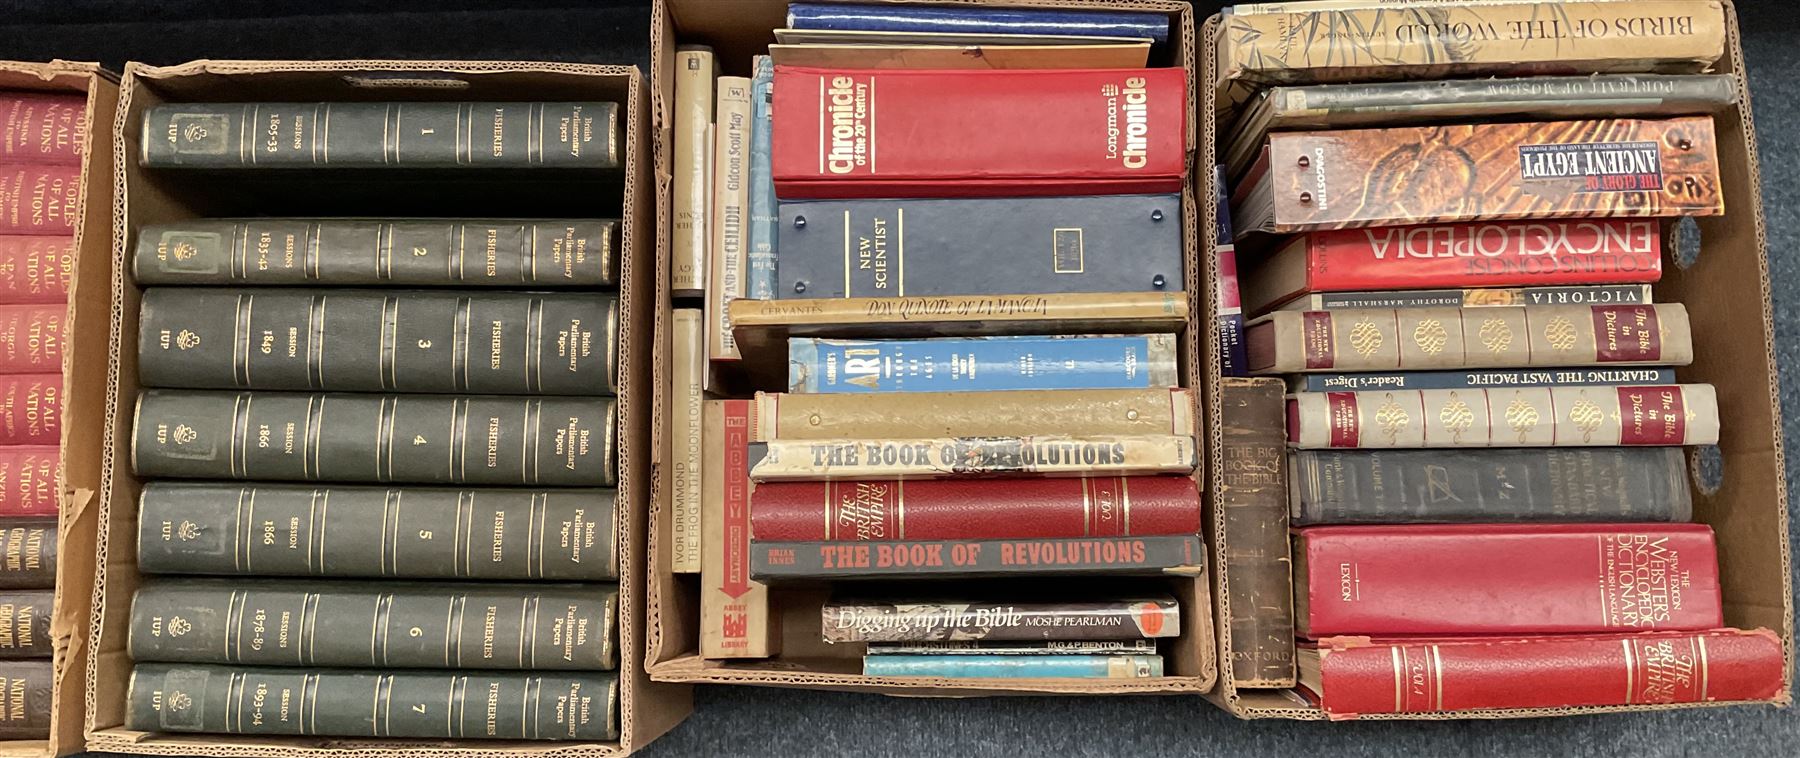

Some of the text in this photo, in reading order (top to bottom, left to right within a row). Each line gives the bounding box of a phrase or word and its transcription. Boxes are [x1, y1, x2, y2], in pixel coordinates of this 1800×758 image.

[1395, 21, 1497, 44] WORLD
[1506, 18, 1567, 40] THE
[1575, 17, 1609, 38] OF
[1616, 15, 1694, 35] BIRDS
[855, 83, 867, 118] Century
[1486, 79, 1675, 95] PORTRAIT OF MOSCOW
[40, 103, 59, 153] NATIONS
[267, 114, 278, 153] 1805-33
[493, 108, 503, 157] FISHERIES
[728, 112, 741, 131] May
[828, 76, 854, 173] Chronicle
[1106, 98, 1119, 159] Longman
[1122, 77, 1147, 168] Chronicle
[855, 138, 866, 154] the
[855, 155, 865, 165] of
[727, 158, 741, 191] Gideon
[1522, 149, 1657, 178] ANCIENT EGYPT
[1602, 175, 1637, 189] GLORY
[1640, 174, 1660, 189] THE
[32, 173, 49, 226] NATIONS
[48, 179, 63, 222] OF ALL
[259, 233, 270, 270] 1835-42
[486, 229, 496, 276] FISHERIES
[860, 237, 870, 269] NEW
[874, 218, 886, 288] SCIENTIST
[1365, 222, 1652, 258] ENCYCLOPEDIA
[1465, 255, 1651, 276] COLLINS CONCISE
[761, 305, 823, 317] CERVANTES
[868, 300, 895, 315] DON
[899, 299, 951, 320] QUIXOTE
[957, 300, 975, 315] OF
[1353, 299, 1403, 307] MARSHALL
[1410, 297, 1458, 305] DOROTHY
[1532, 291, 1637, 304] VICTORIA
[161, 331, 170, 349] IUP
[261, 331, 272, 353] 1849
[289, 327, 297, 357] SESSION
[419, 340, 431, 348] 3
[492, 320, 501, 369] FISHERIES
[558, 331, 566, 356] Papers
[569, 320, 579, 372] Parliamentary
[582, 331, 590, 356] British
[1219, 321, 1232, 369] Dictionary of
[1229, 320, 1238, 345] Pocket
[1604, 311, 1616, 351] Pictures
[1622, 326, 1632, 336] in
[1635, 309, 1646, 354] The Bible
[844, 348, 880, 389] ART
[1325, 375, 1405, 388] Reader's Digest
[1466, 370, 1659, 386] CHARTING THE VAST PACIFIC
[26, 382, 42, 436] NATIONS
[727, 417, 746, 426] THE
[1630, 394, 1643, 435] Pictures
[1649, 409, 1656, 420] in
[1661, 391, 1675, 439] The Bible
[259, 425, 270, 447] 1866
[285, 423, 295, 454] SESSION
[414, 435, 427, 445] 4
[488, 417, 499, 467] FISHERIES
[555, 430, 564, 455] Papers
[566, 417, 578, 469] Parliamentary
[579, 430, 587, 455] British
[810, 443, 931, 467] THE BOOK
[1226, 460, 1261, 470] BOOK
[1227, 448, 1277, 458] THE BIG
[689, 383, 699, 562] THE FROG IN THE MOONFLOWER
[730, 432, 741, 518] ABBEY
[1225, 474, 1282, 484] THE BIBLE
[676, 462, 684, 563] IVOR DRUMMOND
[840, 495, 855, 527] THE
[857, 483, 870, 540] BRITISH
[871, 484, 887, 537] EMPIRE
[1101, 502, 1111, 521] VOL
[264, 521, 274, 544] 1866
[289, 517, 299, 548] SESSION
[419, 530, 432, 539] 5
[493, 511, 504, 562] FISHERIES
[7, 528, 26, 571] GEOGRAPHIC
[25, 528, 43, 570] NATIONAL
[768, 549, 795, 557] BRIAN
[768, 557, 795, 565] INNES
[820, 540, 1147, 569] THE BOOK OF REVOLUTIONS
[1341, 563, 1351, 602] LEXICON
[1617, 534, 1637, 628] DICTIONARY
[1634, 535, 1654, 631] ENCYCLOPEDIC
[1649, 537, 1670, 622] WEBSTER'S
[1669, 550, 1682, 610] NEW LEXICON
[1681, 570, 1690, 588] THE
[18, 606, 33, 648] NATIONAL
[252, 609, 264, 650] 1878-89
[280, 611, 290, 647] SESSIONS
[410, 627, 423, 637] 6
[484, 606, 496, 658] FISHERIES
[837, 606, 1122, 634] Digging up the Bible MOSHE PEARLMAN
[1234, 651, 1289, 662] OXFORD
[1658, 640, 1676, 700] BRITISH
[1675, 655, 1693, 688] THE
[1413, 663, 1424, 685] VOL
[1643, 645, 1662, 702] EMPIRE
[10, 678, 26, 721] NATIONAL
[152, 692, 162, 710] IUP
[253, 683, 265, 725] 1893-94
[281, 689, 290, 721] SESSION
[412, 704, 425, 713] 7
[487, 682, 499, 735] FISHERIES
